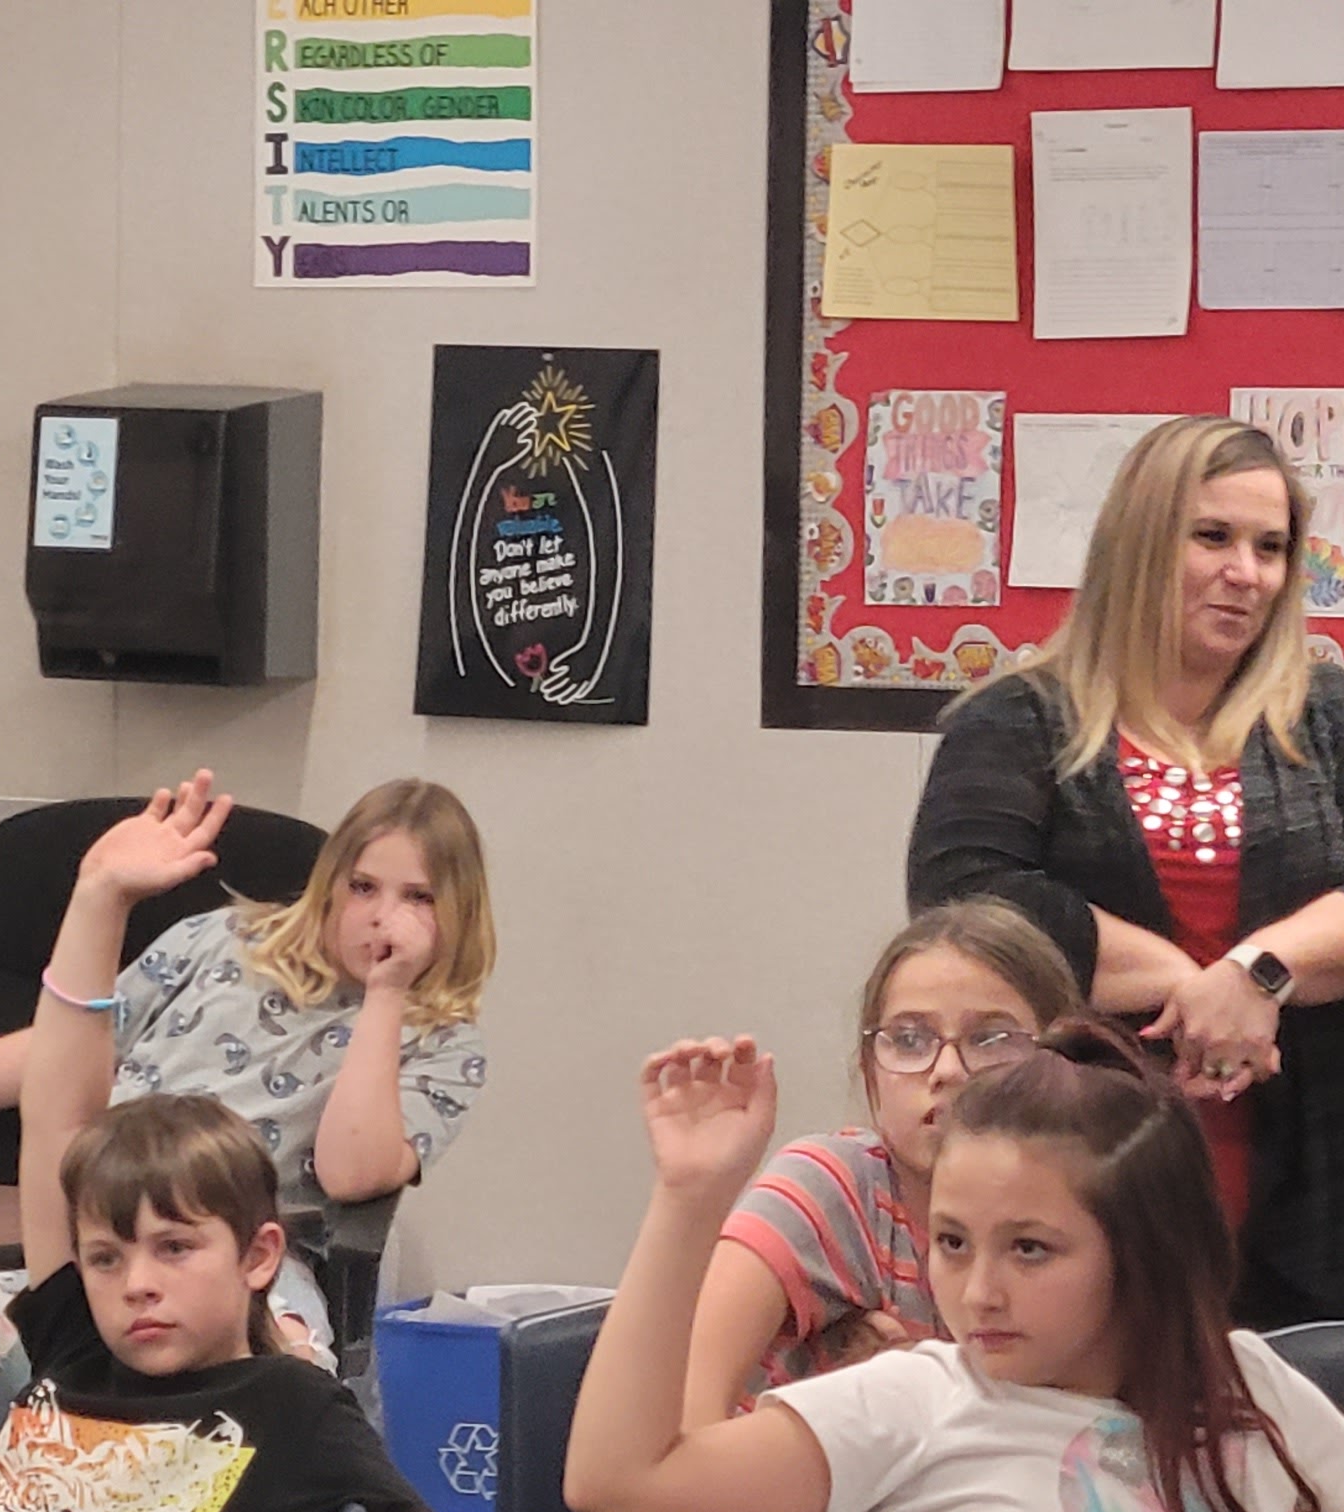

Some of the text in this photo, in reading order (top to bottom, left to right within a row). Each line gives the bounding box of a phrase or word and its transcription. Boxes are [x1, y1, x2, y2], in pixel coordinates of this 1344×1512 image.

[300, 45, 413, 68] EGARDLESS
[420, 44, 448, 67] OF
[423, 95, 500, 118] GENDER
[300, 148, 398, 173] NTELLECT
[299, 201, 374, 224] ALENTS
[382, 200, 409, 222] OR
[261, 235, 291, 277] Y
[891, 394, 980, 433] GOOD
[893, 434, 969, 471] THINGS
[894, 472, 976, 520] TAKE
[539, 535, 564, 555] let
[486, 586, 513, 609] you
